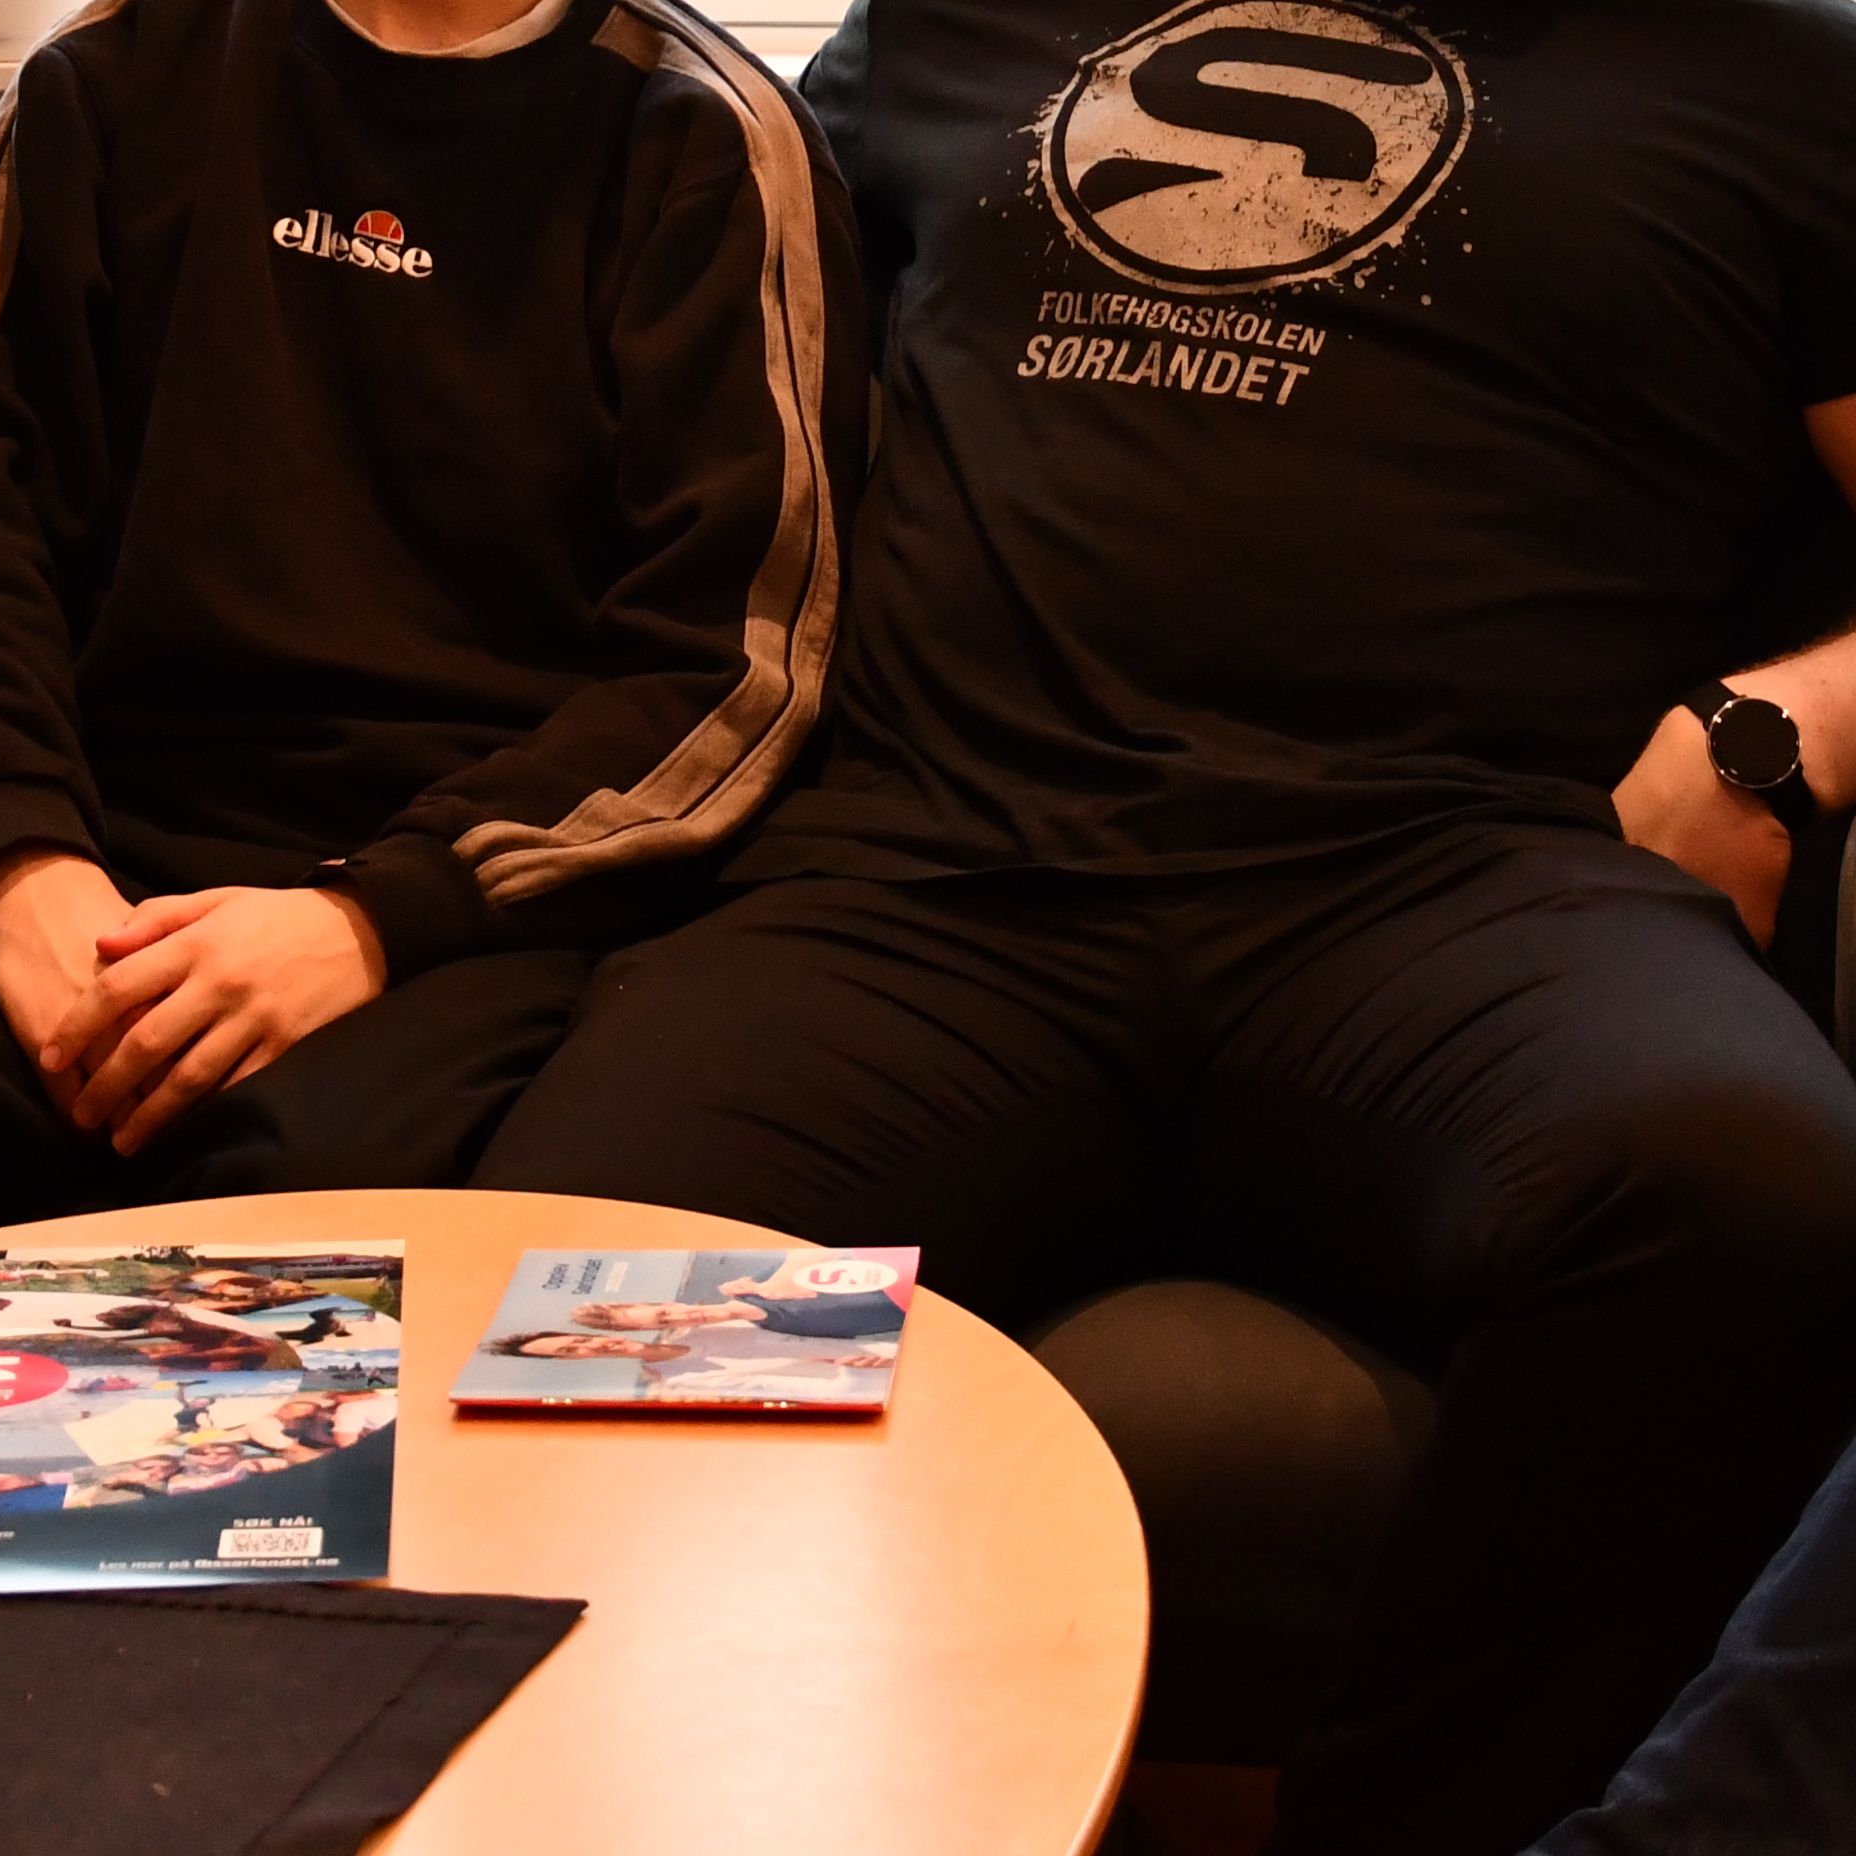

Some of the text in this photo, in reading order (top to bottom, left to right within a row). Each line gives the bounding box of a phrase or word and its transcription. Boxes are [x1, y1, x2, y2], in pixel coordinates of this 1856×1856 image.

[272, 208, 434, 278] ellesse
[1037, 290, 1327, 358] FOLKEHØGSKOLEN
[1016, 333, 1311, 408] SØRLANDET
[232, 1515, 314, 1528] SØK NÅ!
